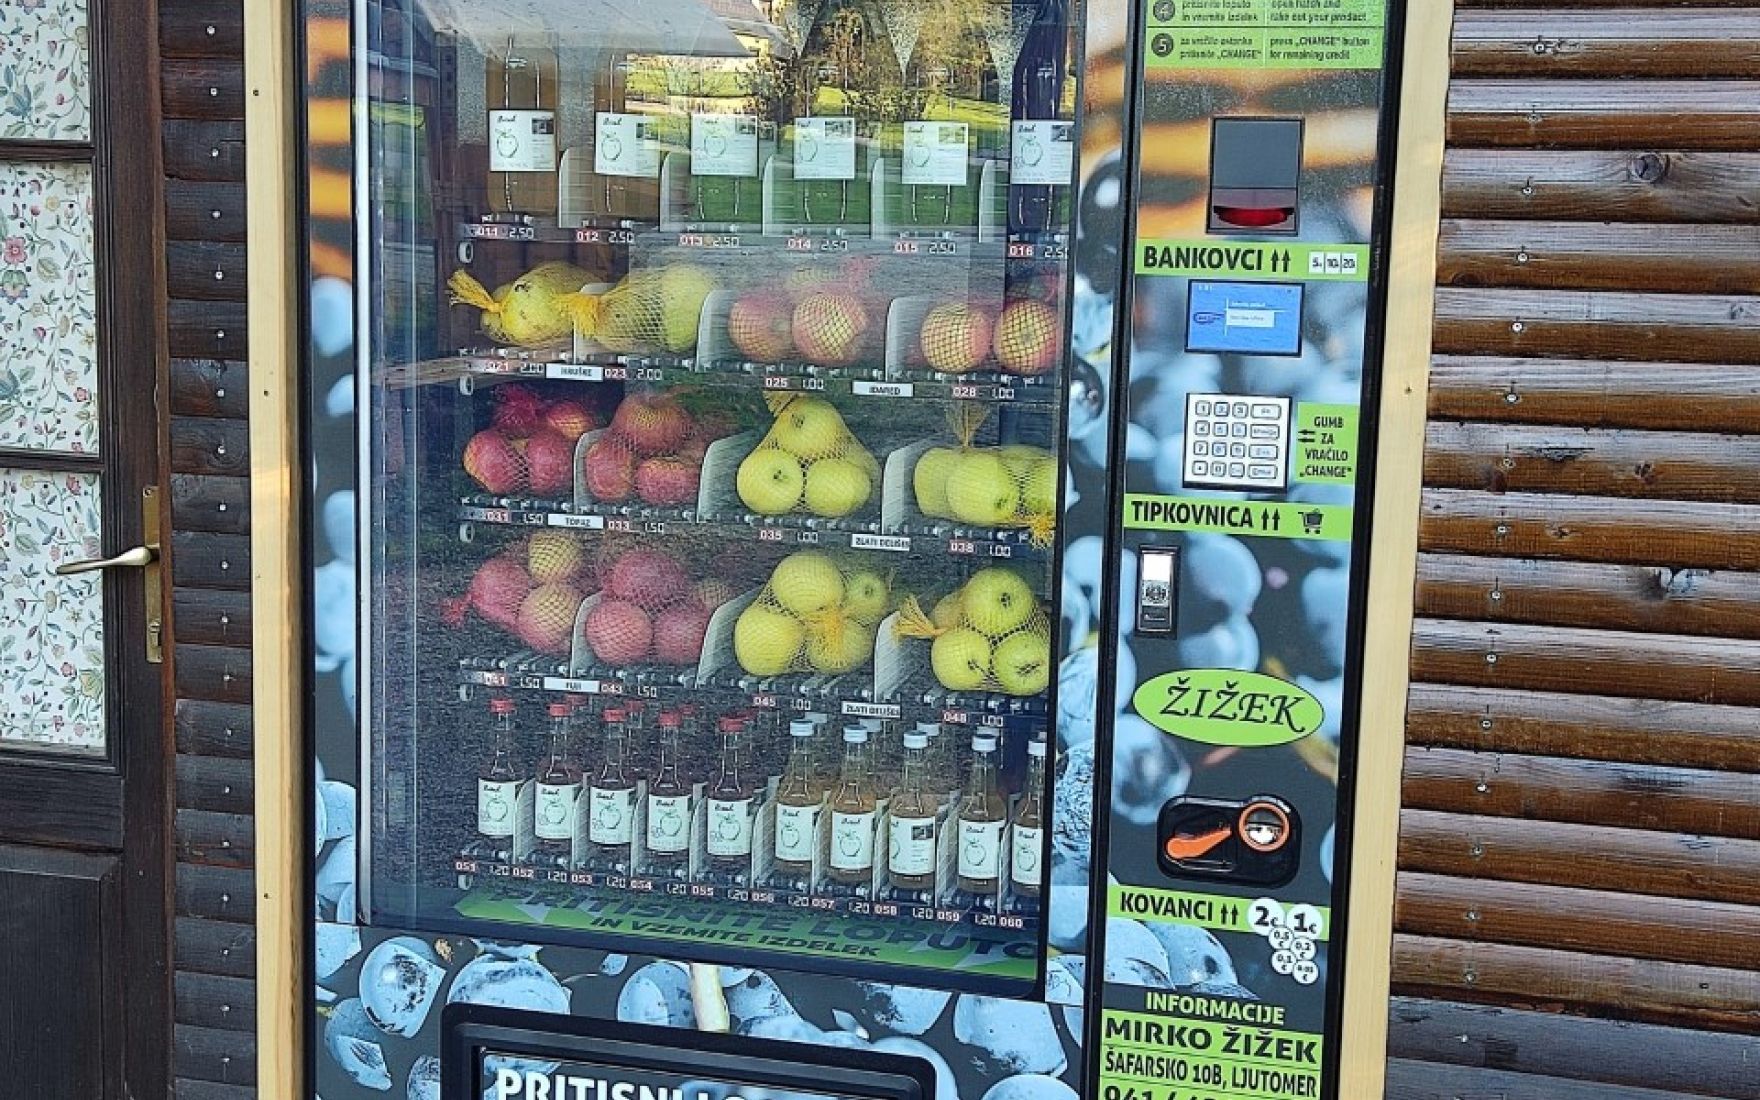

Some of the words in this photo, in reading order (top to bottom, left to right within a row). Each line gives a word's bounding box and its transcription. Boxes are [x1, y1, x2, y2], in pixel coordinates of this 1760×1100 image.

[1308, 14, 1329, 24] your
[1330, 12, 1367, 24] product
[1158, 38, 1168, 53] 5
[1143, 245, 1263, 272] BANKOVCI
[1314, 416, 1344, 429] GUMB
[1321, 433, 1335, 445] ZA
[1130, 500, 1254, 528] TIPKOVNICA
[1160, 676, 1306, 733] ŽIŽEK
[512, 866, 535, 878] 052
[571, 873, 593, 884] 053
[630, 879, 653, 891] 054
[692, 885, 714, 896] 055
[811, 898, 836, 909] 057
[874, 904, 898, 916] 058
[1120, 891, 1213, 922] KOVANCI
[936, 911, 960, 922] 059
[590, 916, 623, 928] IN
[631, 920, 753, 942] VZEMITE
[758, 935, 880, 957] IZDELEK
[1145, 991, 1286, 1025] INFORMACIJE
[1105, 1017, 1213, 1050] MIRKO
[1221, 1026, 1317, 1064] ŽIŽEK
[1105, 1045, 1188, 1081] ŠAFARSKO
[1192, 1063, 1227, 1090] 10B,
[1231, 1066, 1317, 1098] LJUTOMER
